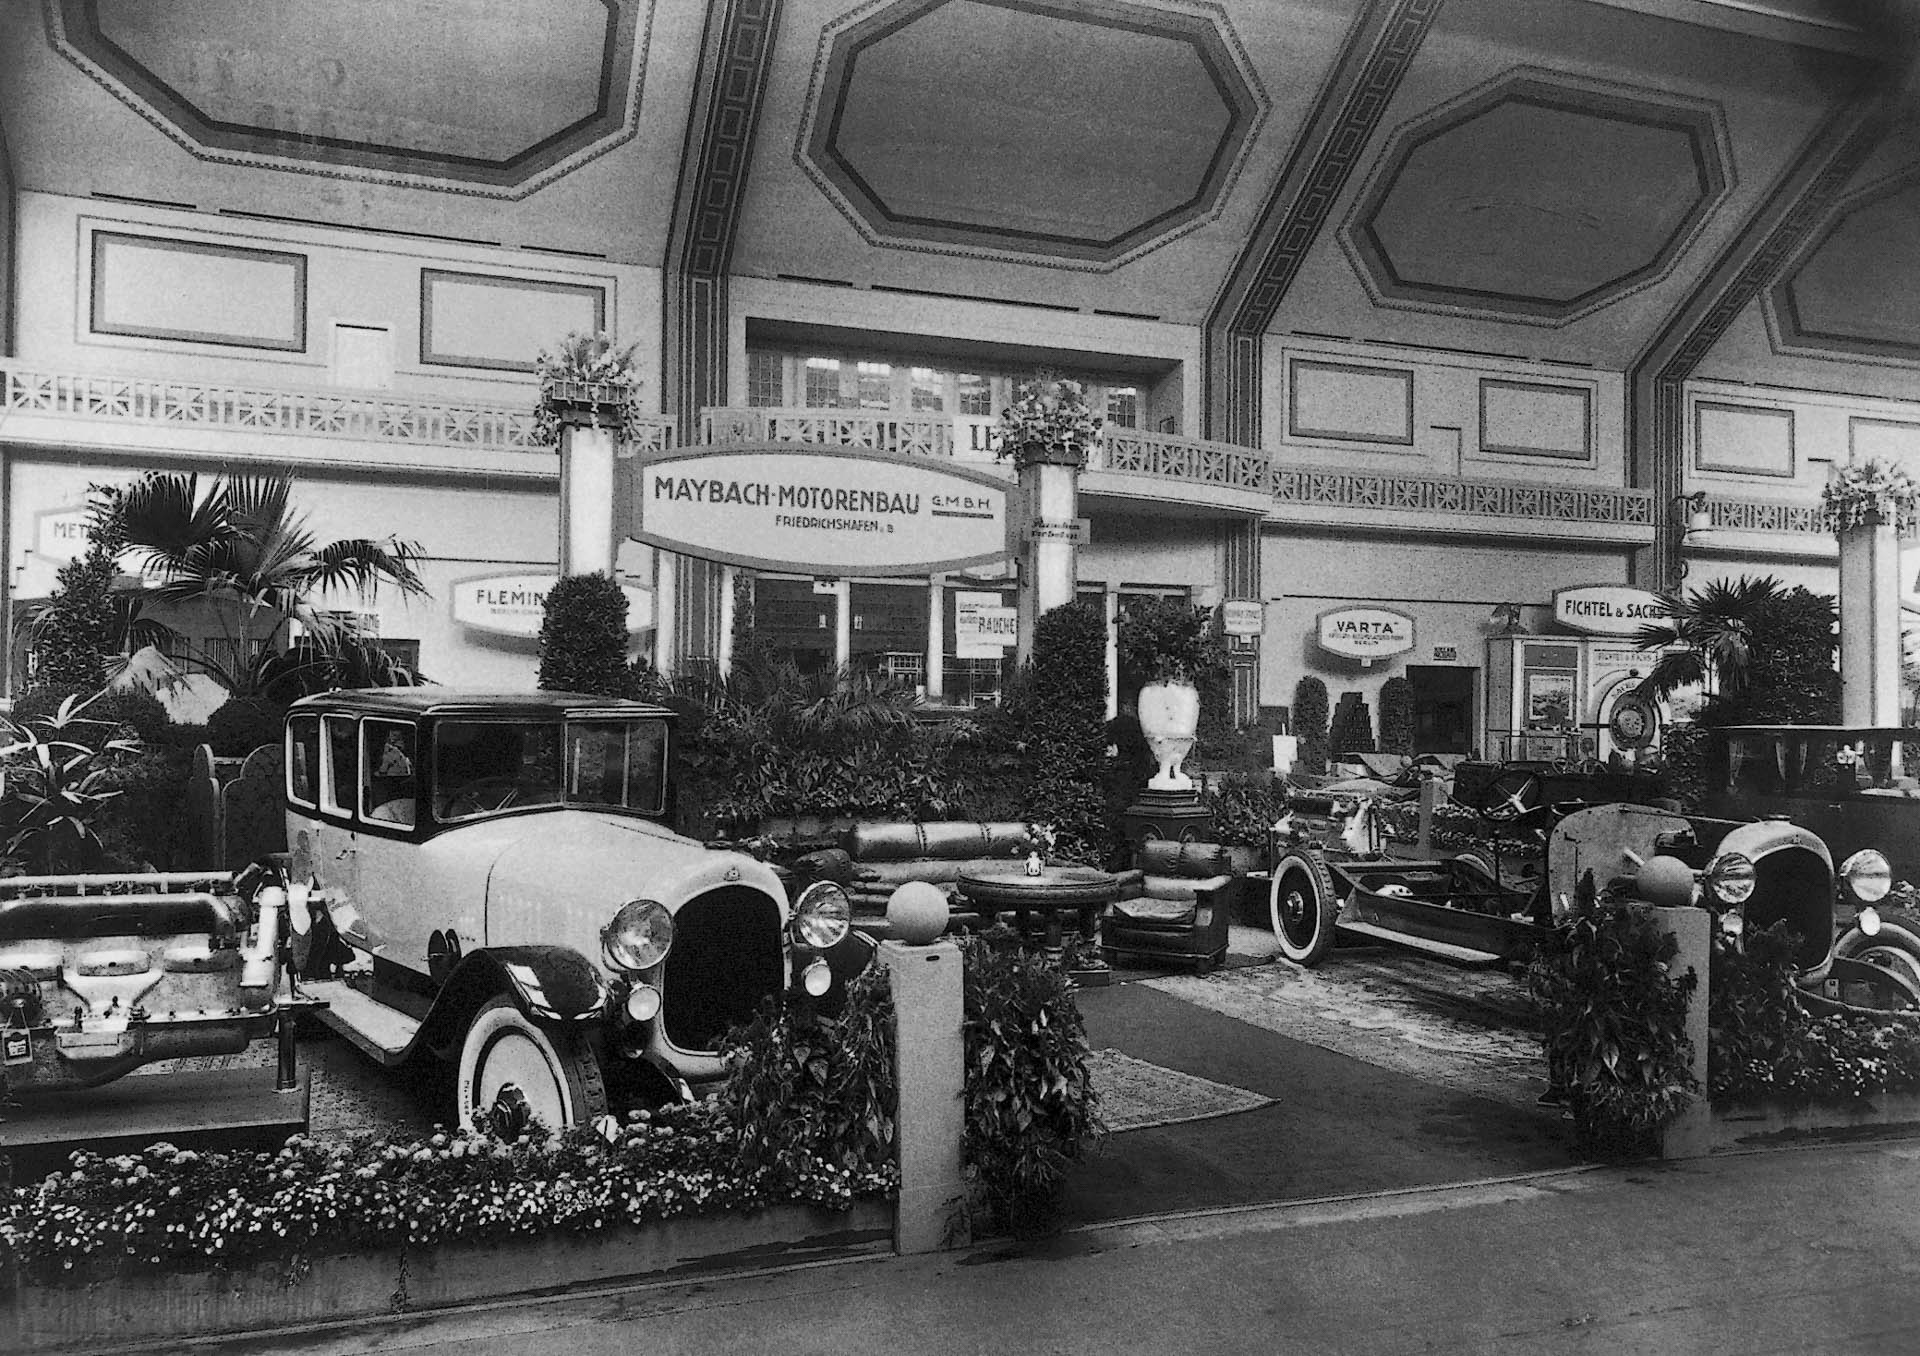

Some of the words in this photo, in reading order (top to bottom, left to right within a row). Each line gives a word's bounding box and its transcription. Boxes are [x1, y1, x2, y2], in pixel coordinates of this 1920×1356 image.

[477, 589, 548, 607] FLEMIN
[1565, 600, 1613, 617] FICHTEL
[1615, 607, 1624, 618] &
